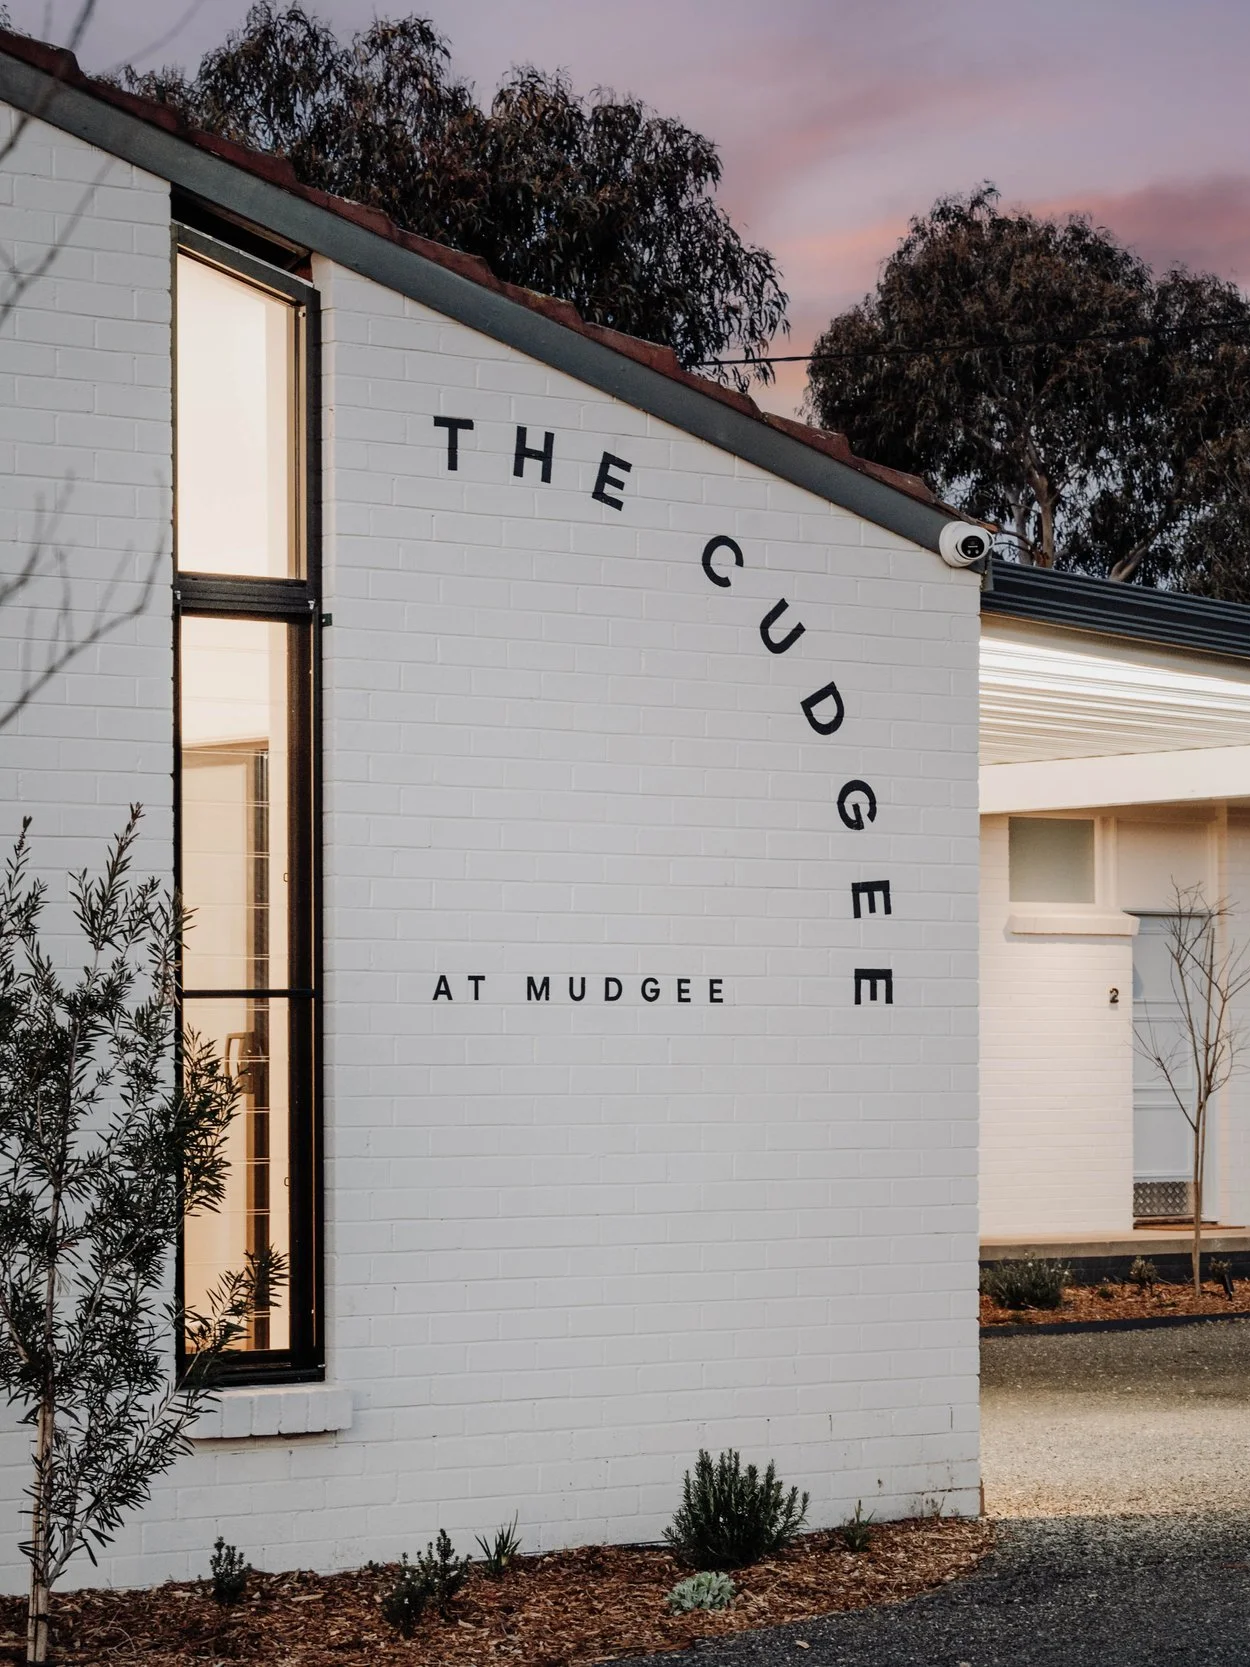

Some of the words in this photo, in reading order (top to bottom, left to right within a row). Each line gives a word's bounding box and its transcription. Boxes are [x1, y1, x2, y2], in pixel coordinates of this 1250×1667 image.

[432, 415, 633, 512] THE
[701, 534, 894, 1006] CUDGEE
[432, 974, 486, 1001] AT
[526, 976, 724, 1004] MUDGEE
[1109, 987, 1119, 1004] 2
